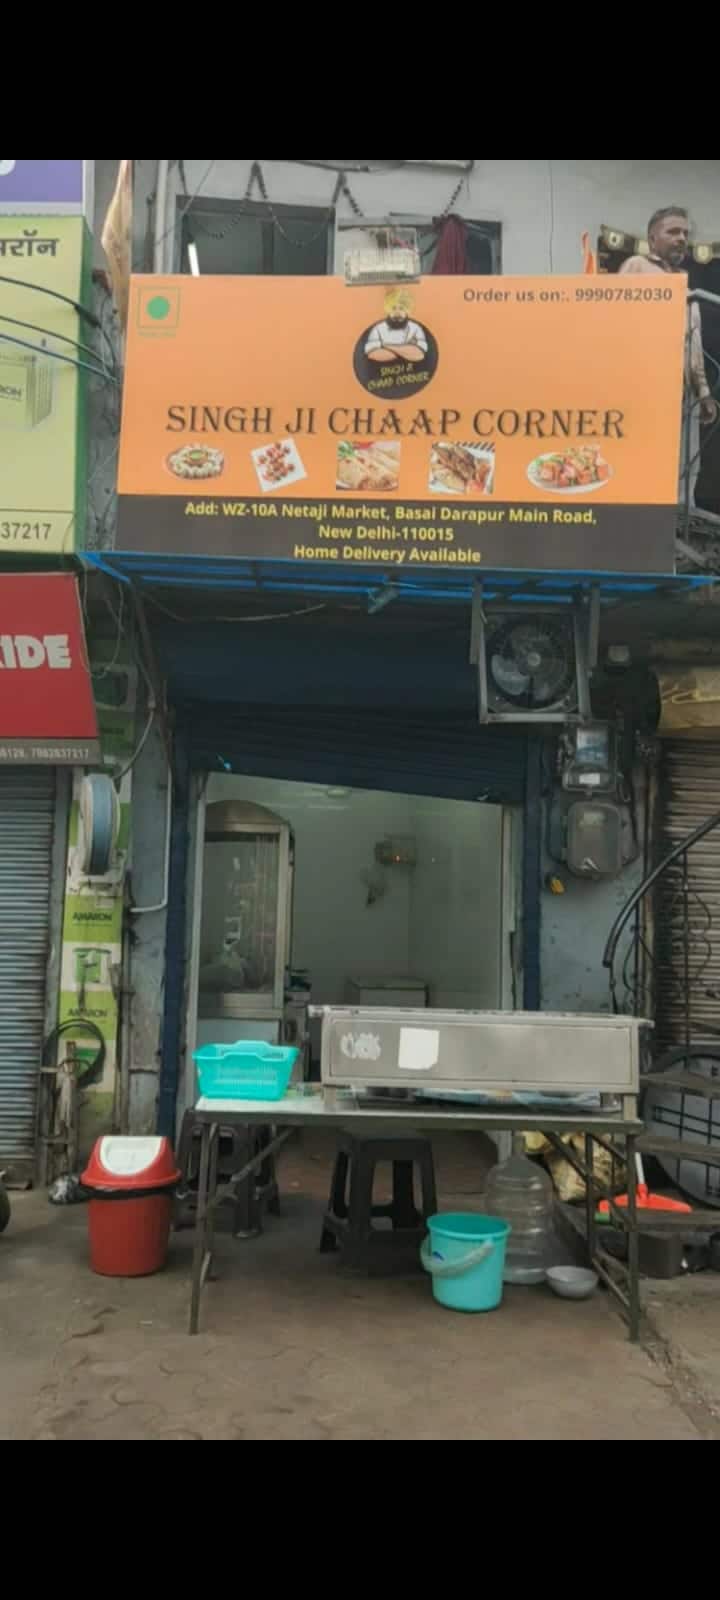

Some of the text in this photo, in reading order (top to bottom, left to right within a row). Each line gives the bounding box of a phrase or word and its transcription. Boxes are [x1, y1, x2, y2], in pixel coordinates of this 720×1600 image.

[463, 288, 510, 301] Order
[516, 291, 534, 301] us
[575, 287, 673, 302] 9990782030
[166, 405, 626, 439] SINGH JI CHAAP CORNER
[185, 502, 219, 516] Add:
[222, 503, 279, 518] WZ-10A
[282, 503, 328, 521] Netaji
[331, 505, 390, 520] Market,
[440, 508, 504, 525] Darapur
[509, 508, 548, 522] Main
[553, 509, 597, 525] Road,
[1, 522, 52, 540] 37217
[319, 525, 454, 542] New Delhi-110015
[294, 545, 481, 563] Home Delivery Available
